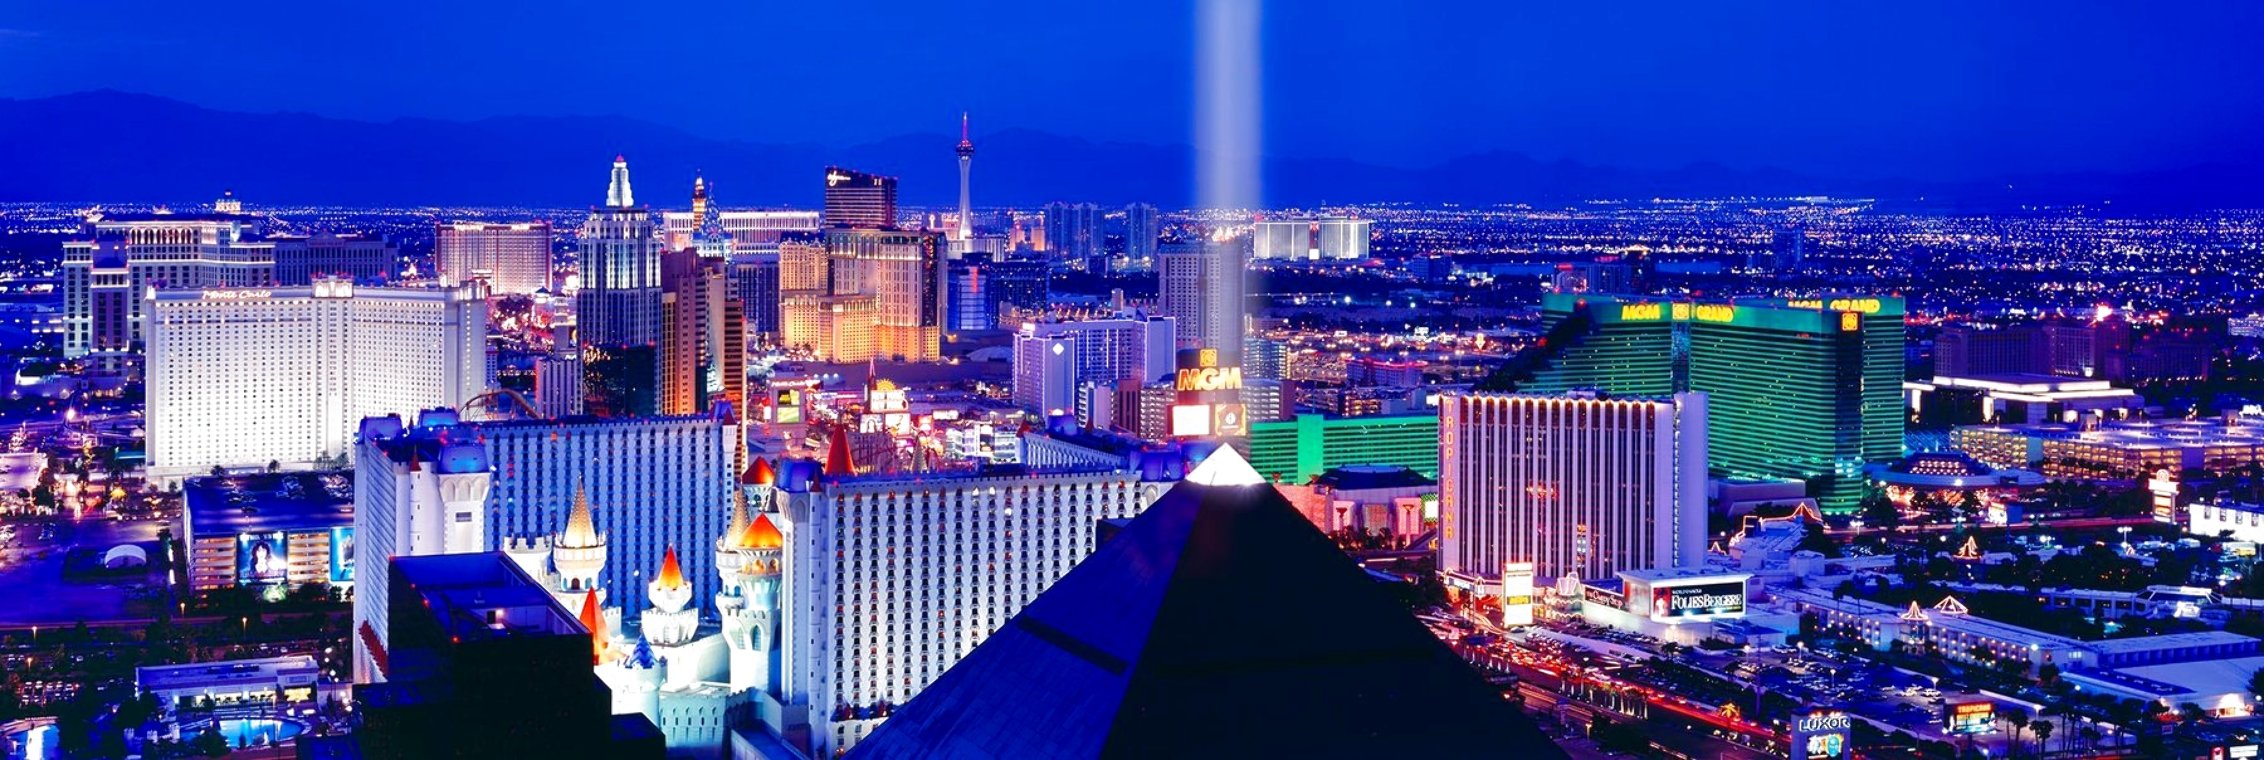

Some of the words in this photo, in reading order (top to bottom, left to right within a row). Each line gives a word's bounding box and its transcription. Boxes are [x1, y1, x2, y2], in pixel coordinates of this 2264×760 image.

[202, 290, 237, 300] Monte
[239, 290, 272, 299] Carlo
[1621, 304, 1661, 321] MGM
[1696, 305, 1734, 322] GRAND
[1829, 299, 1881, 313] GRAND
[1177, 367, 1243, 391] MGM
[1445, 400, 1454, 539] TROPICANA
[1671, 594, 1704, 610] FOLIES
[1799, 716, 1851, 732] LUXOR
